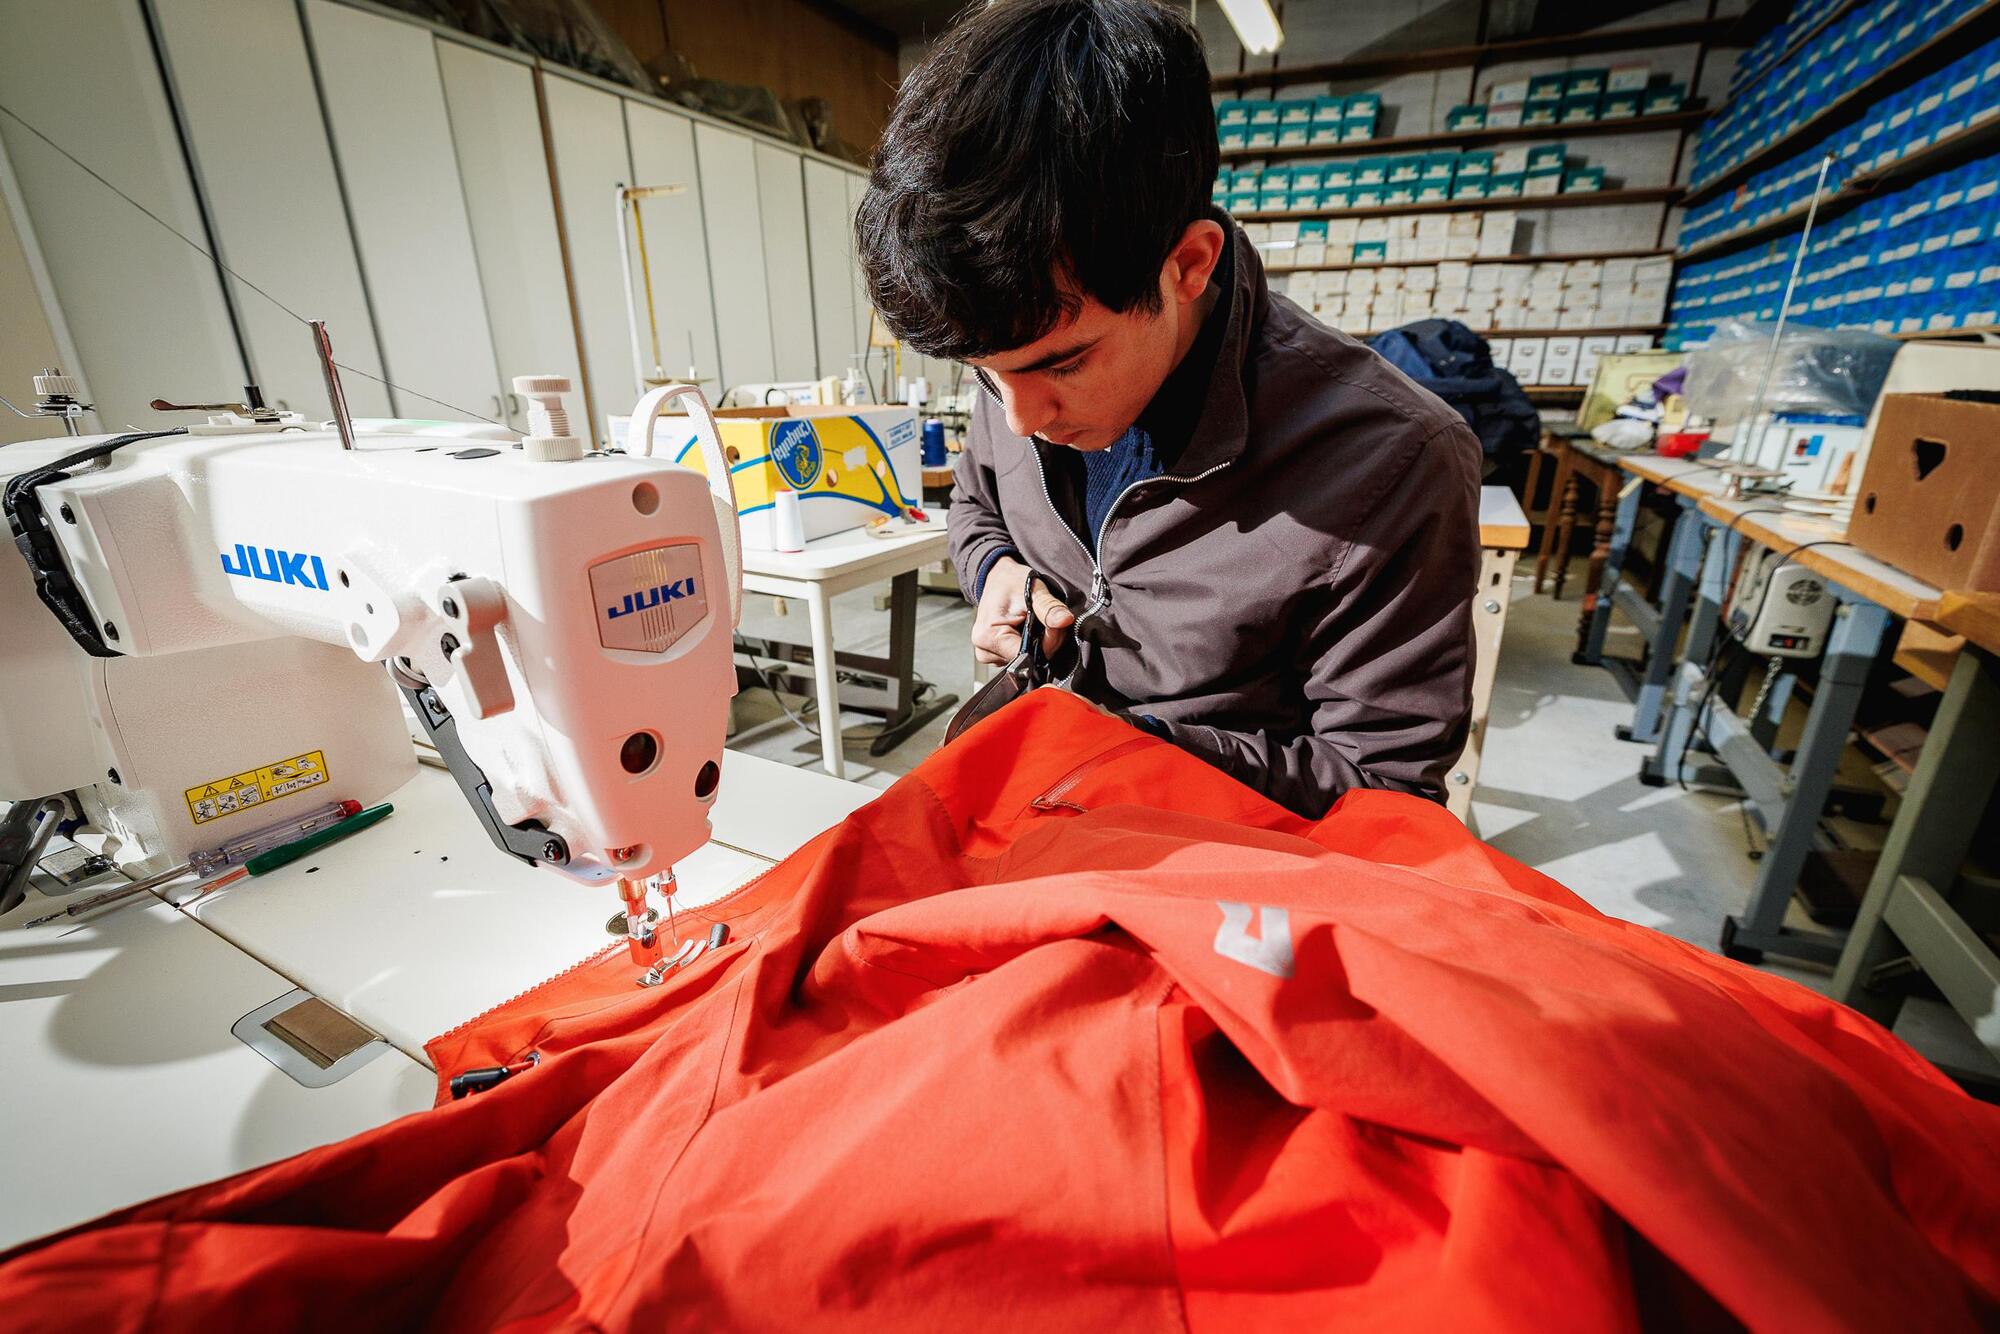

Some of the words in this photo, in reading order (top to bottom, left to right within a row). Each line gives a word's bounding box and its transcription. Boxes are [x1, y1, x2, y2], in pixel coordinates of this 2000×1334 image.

[773, 421, 812, 461] Chiquita
[220, 543, 330, 591] JUKI
[607, 577, 695, 619] JUKI
